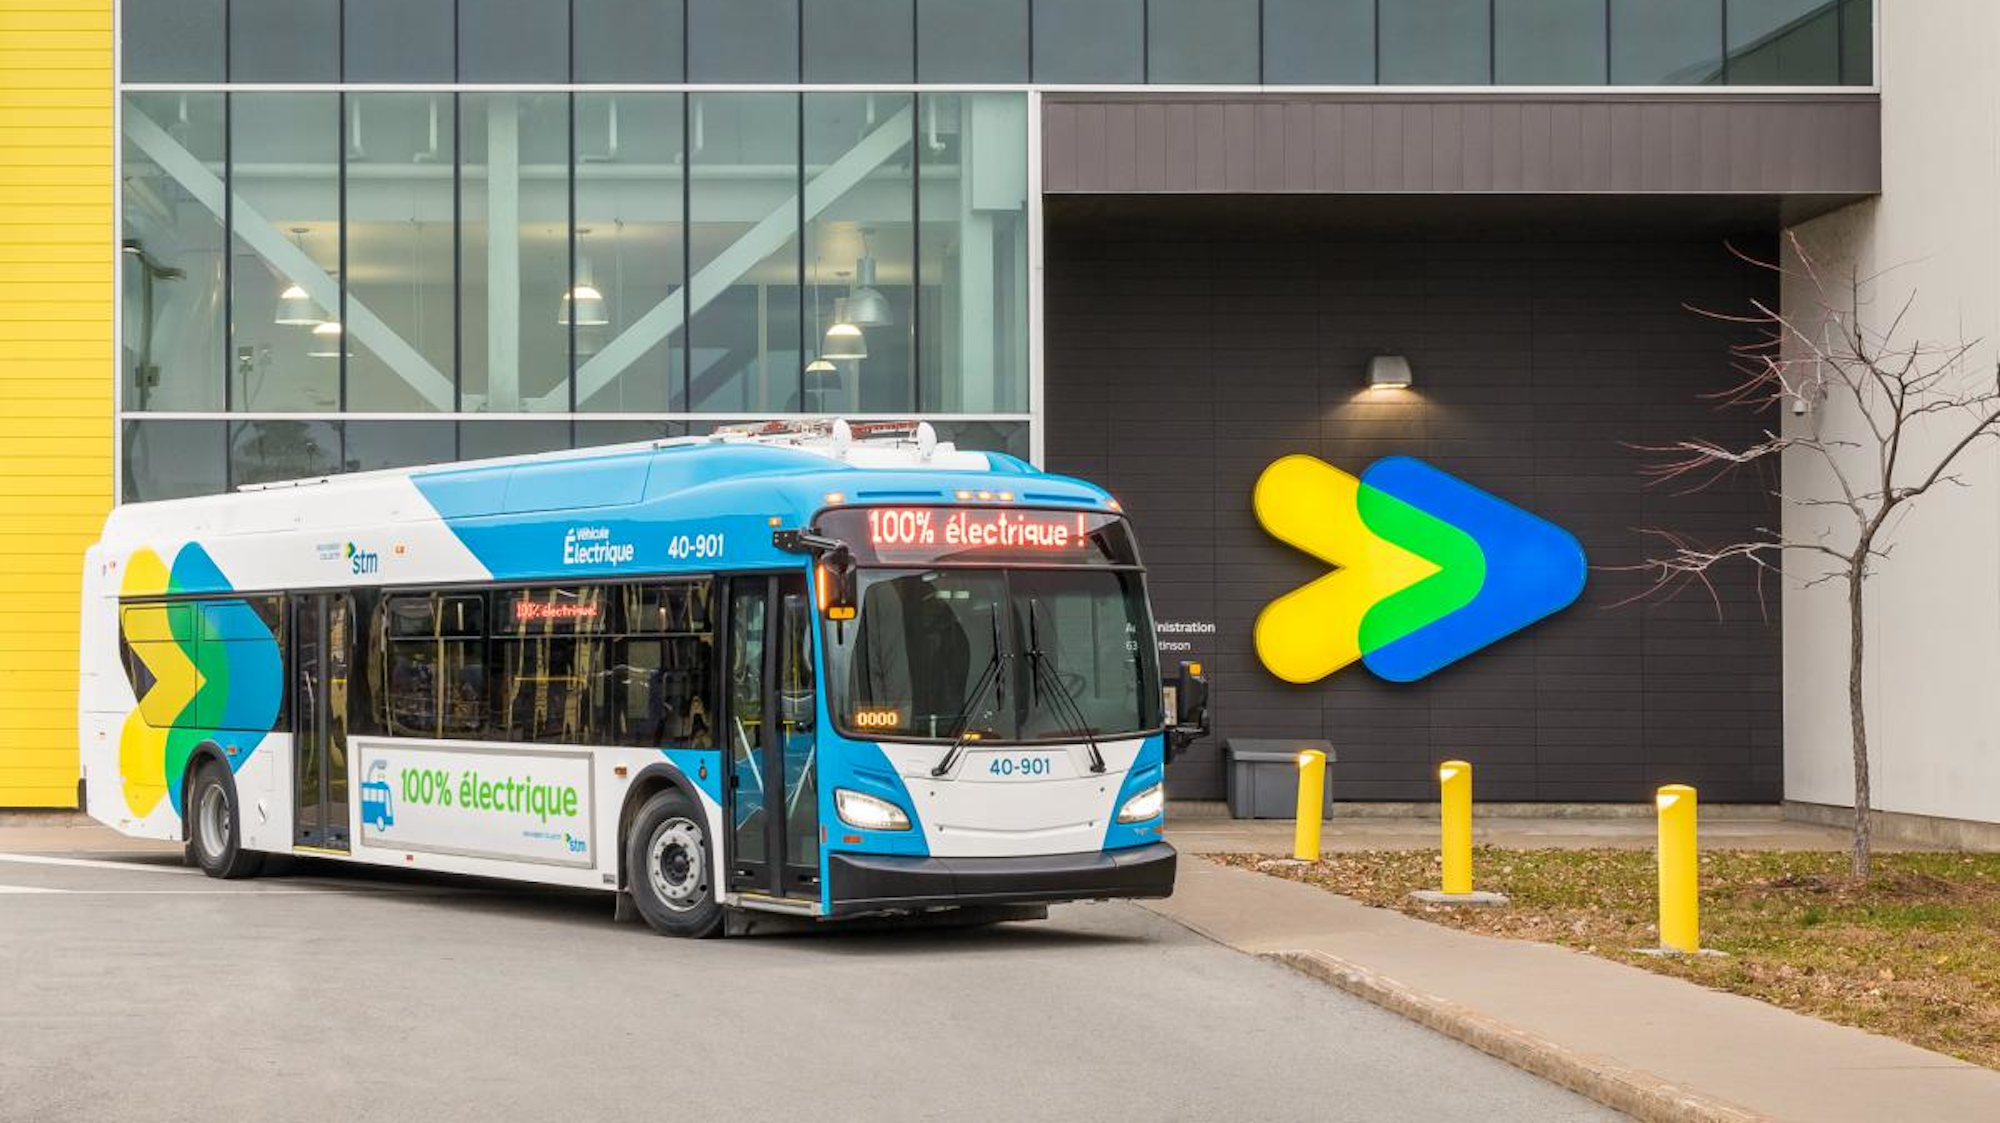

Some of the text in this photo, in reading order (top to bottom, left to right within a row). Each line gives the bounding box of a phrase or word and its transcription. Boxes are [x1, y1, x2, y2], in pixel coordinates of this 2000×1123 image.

[575, 526, 610, 541] Véhicule
[869, 510, 1086, 547] 100% électrique !
[563, 528, 634, 567] Électrique
[668, 533, 725, 559] 40-901
[352, 549, 378, 575] stm
[857, 712, 897, 726] 0000
[989, 757, 1051, 775] 40-901
[401, 768, 578, 823] 100% électrique
